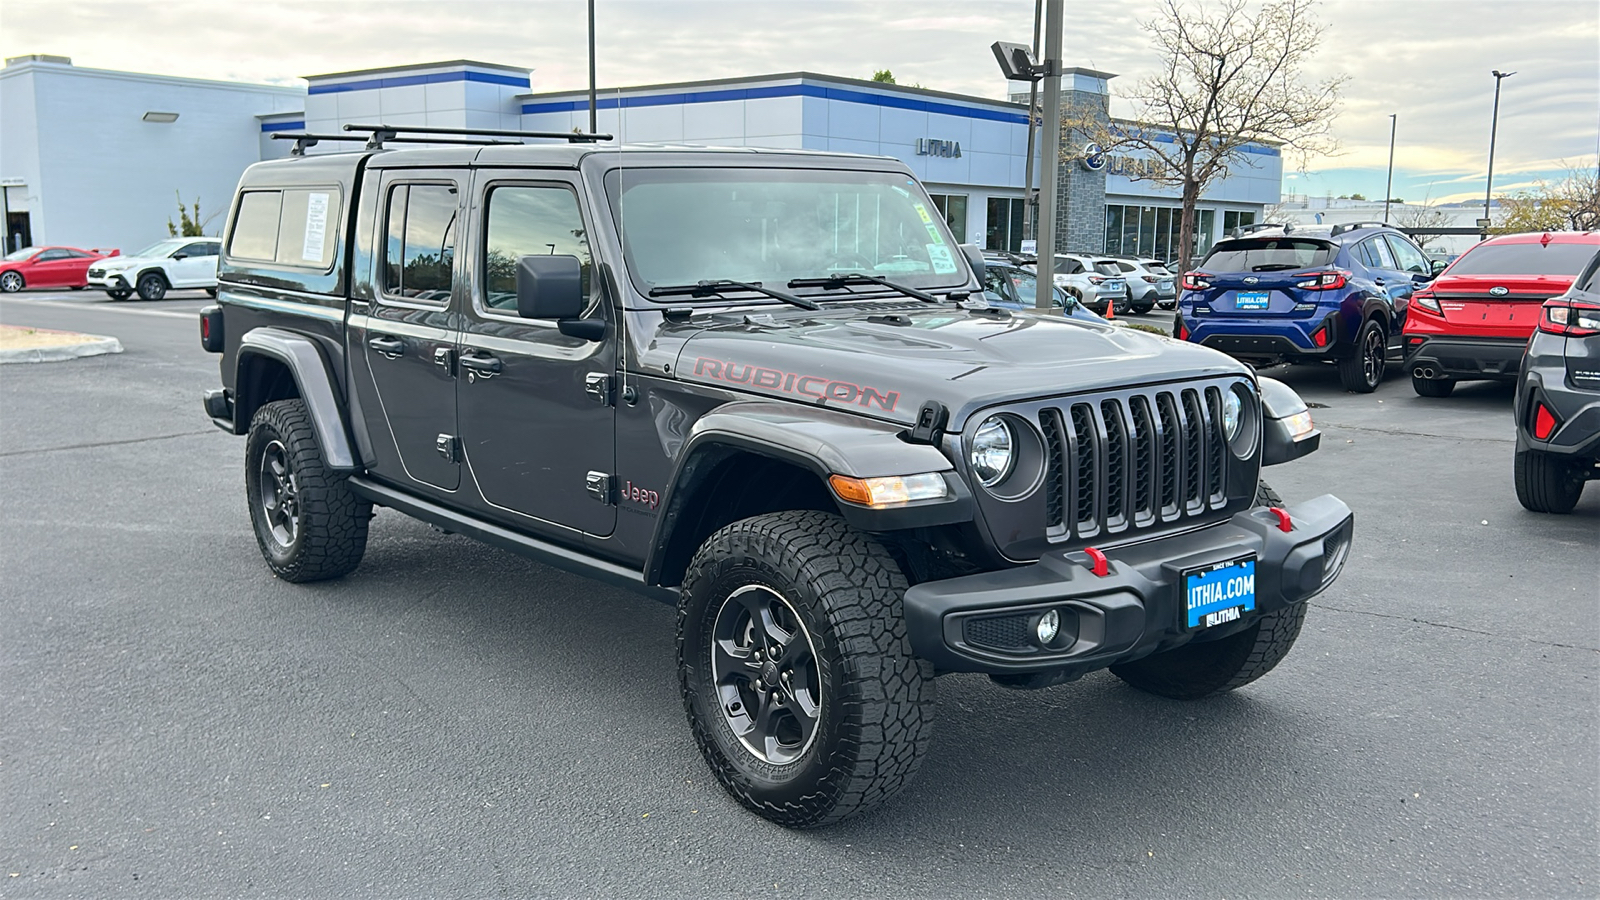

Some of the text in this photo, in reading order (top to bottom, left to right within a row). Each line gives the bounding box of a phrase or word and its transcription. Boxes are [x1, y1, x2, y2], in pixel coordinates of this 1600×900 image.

[916, 138, 962, 158] LITHIA
[1237, 296, 1269, 304] LITHIA.COM
[693, 357, 902, 412] RUBICON
[621, 480, 659, 510] Jeep
[1188, 574, 1254, 610] LITHIA.COM
[1215, 606, 1240, 625] LITHIA
